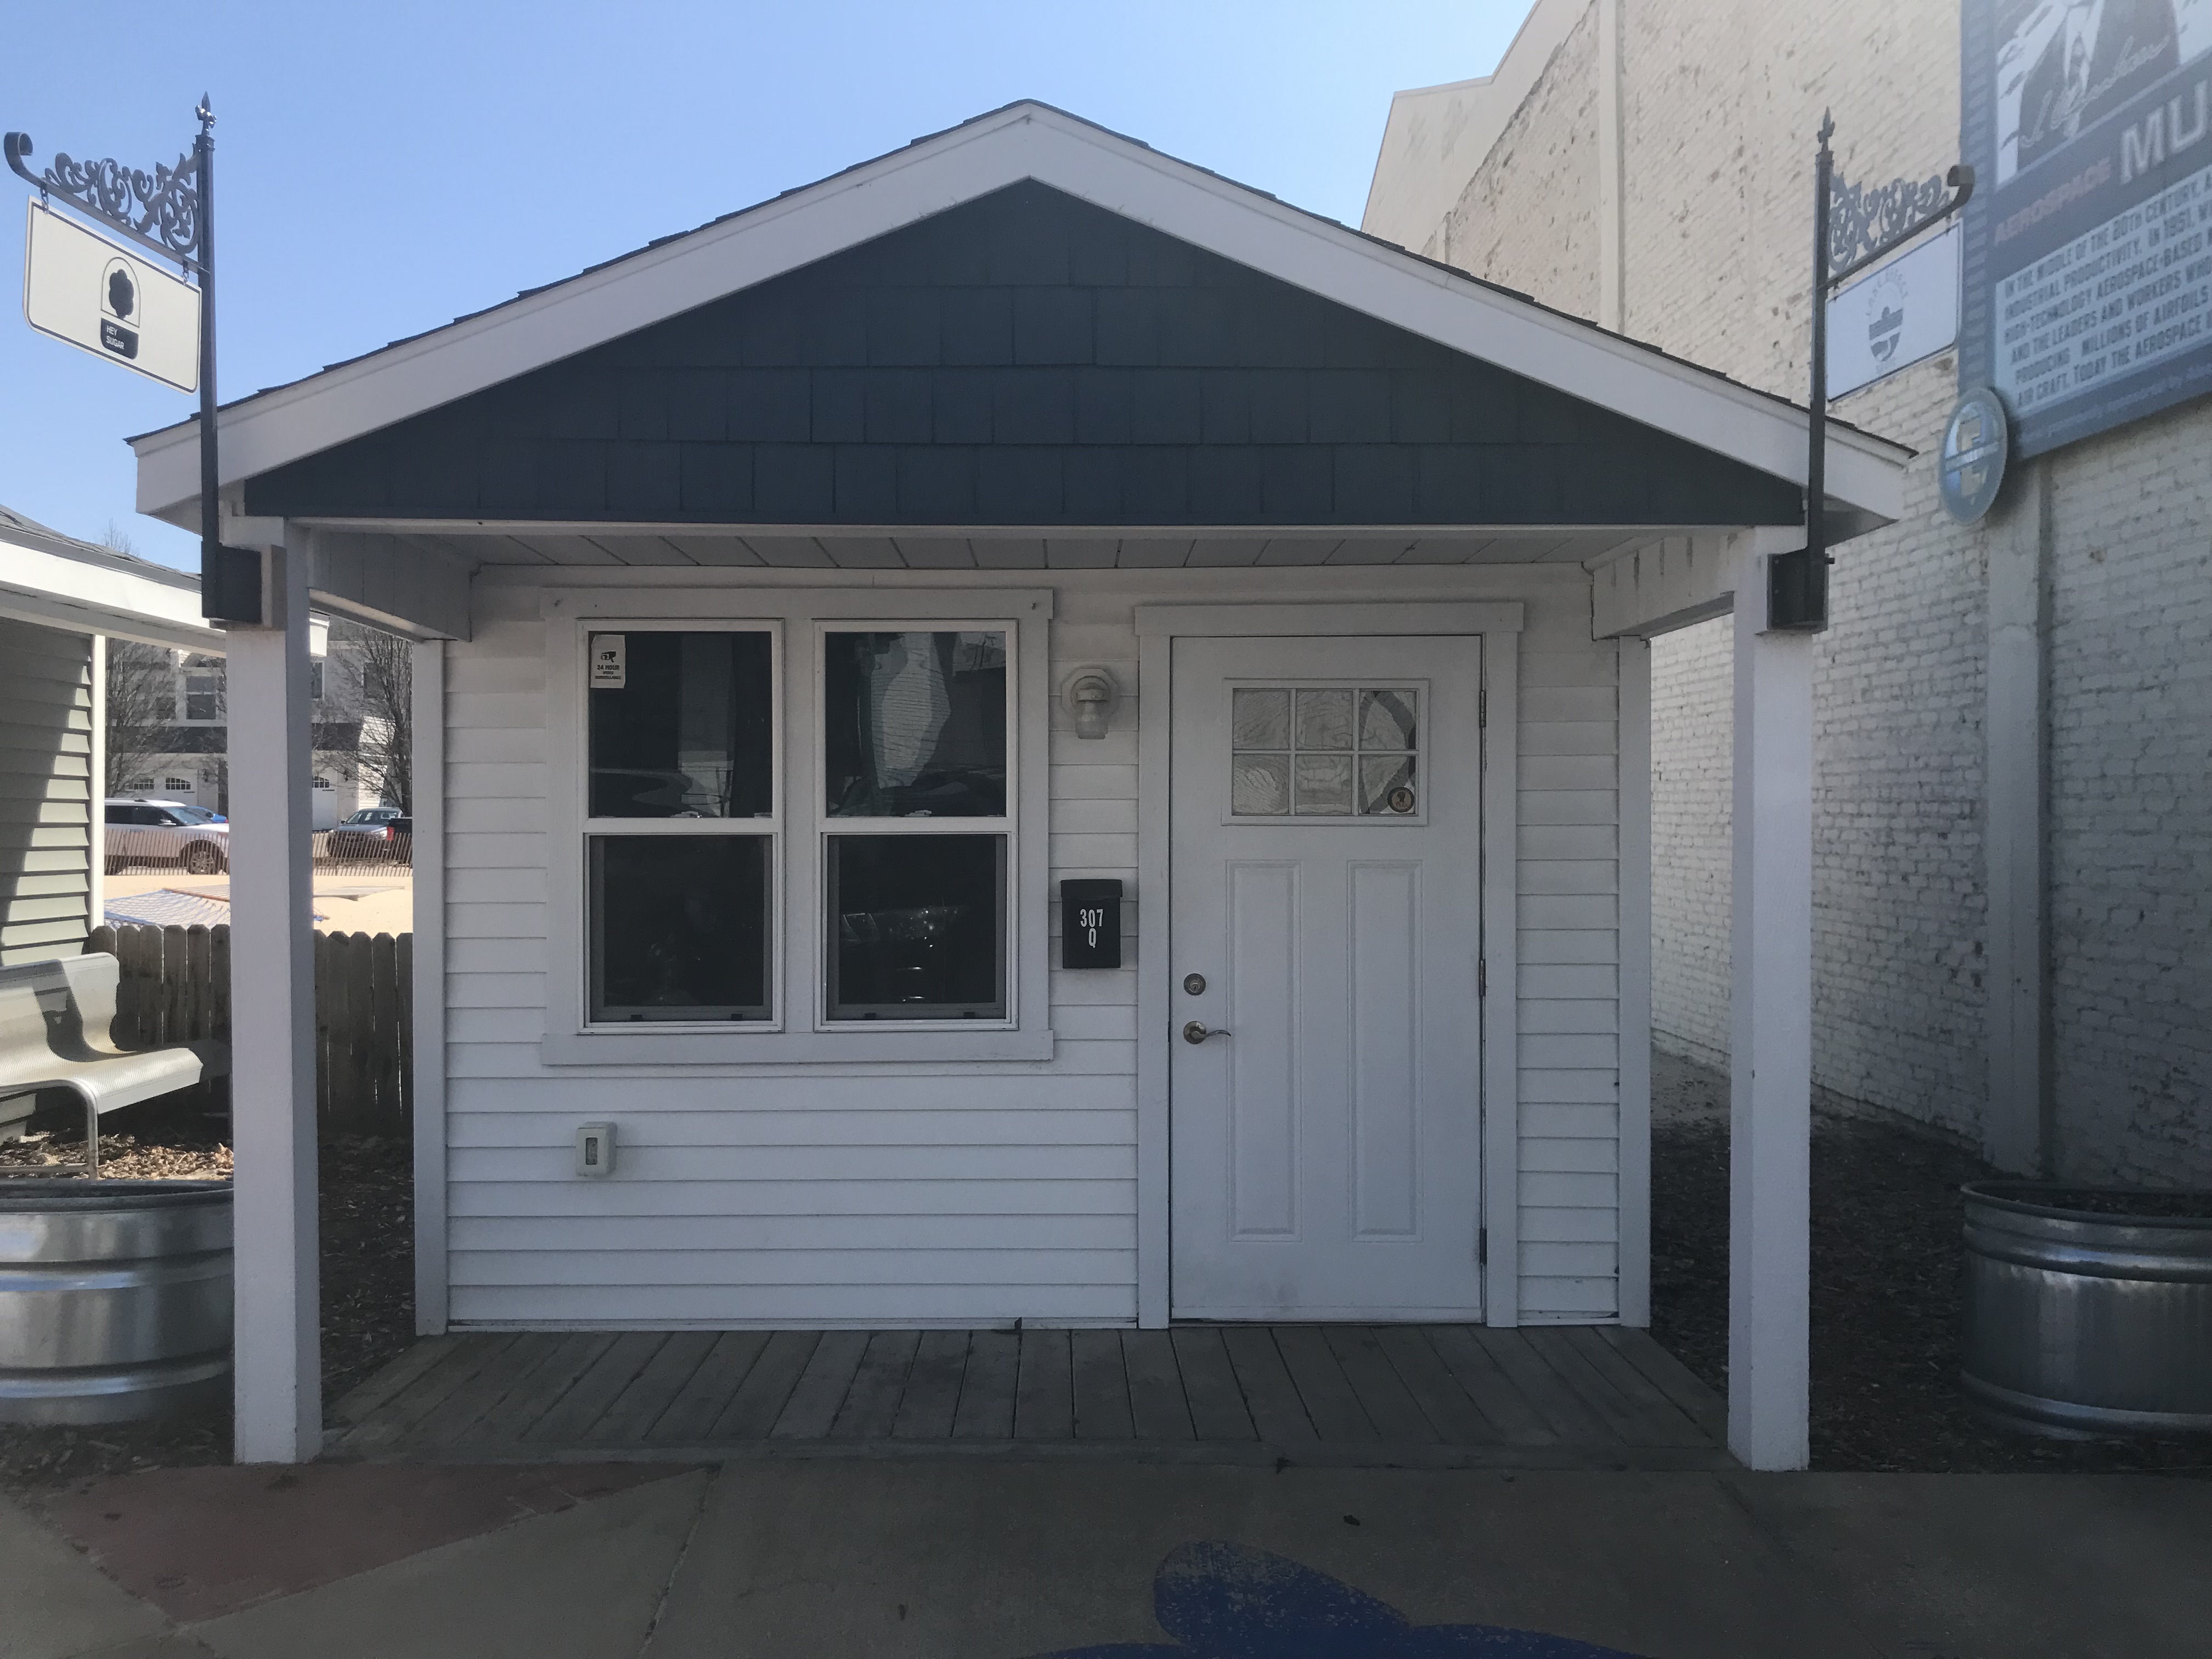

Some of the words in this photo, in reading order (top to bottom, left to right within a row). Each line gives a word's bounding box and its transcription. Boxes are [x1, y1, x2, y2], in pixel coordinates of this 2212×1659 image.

[2005, 280, 2015, 298] IN
[2017, 270, 2033, 291] THE
[2075, 240, 2087, 261] OF
[2091, 227, 2109, 252] THE
[2005, 280, 2061, 320] INDUSTRIAL
[2148, 227, 2160, 247] IN
[106, 325, 118, 336] HEY
[106, 335, 125, 350] SUGAR
[2011, 342, 2030, 365] AND
[2033, 332, 2050, 354] THE
[2052, 311, 2097, 346] LEADERS
[2101, 298, 2123, 323] AND
[2127, 270, 2181, 311] WORKERS
[2016, 347, 2070, 385] PRODUCING
[2081, 319, 2132, 357] MILLIONS
[2135, 311, 2149, 333] OF
[2153, 285, 2209, 325] AIRFOILS
[2018, 387, 2034, 408] AIR
[2074, 356, 2107, 385] TODAY
[2111, 345, 2131, 369] THE
[2135, 314, 2202, 359] AEROSPACE
[1080, 909, 1103, 928] 307
[1088, 928, 1097, 949] Q
